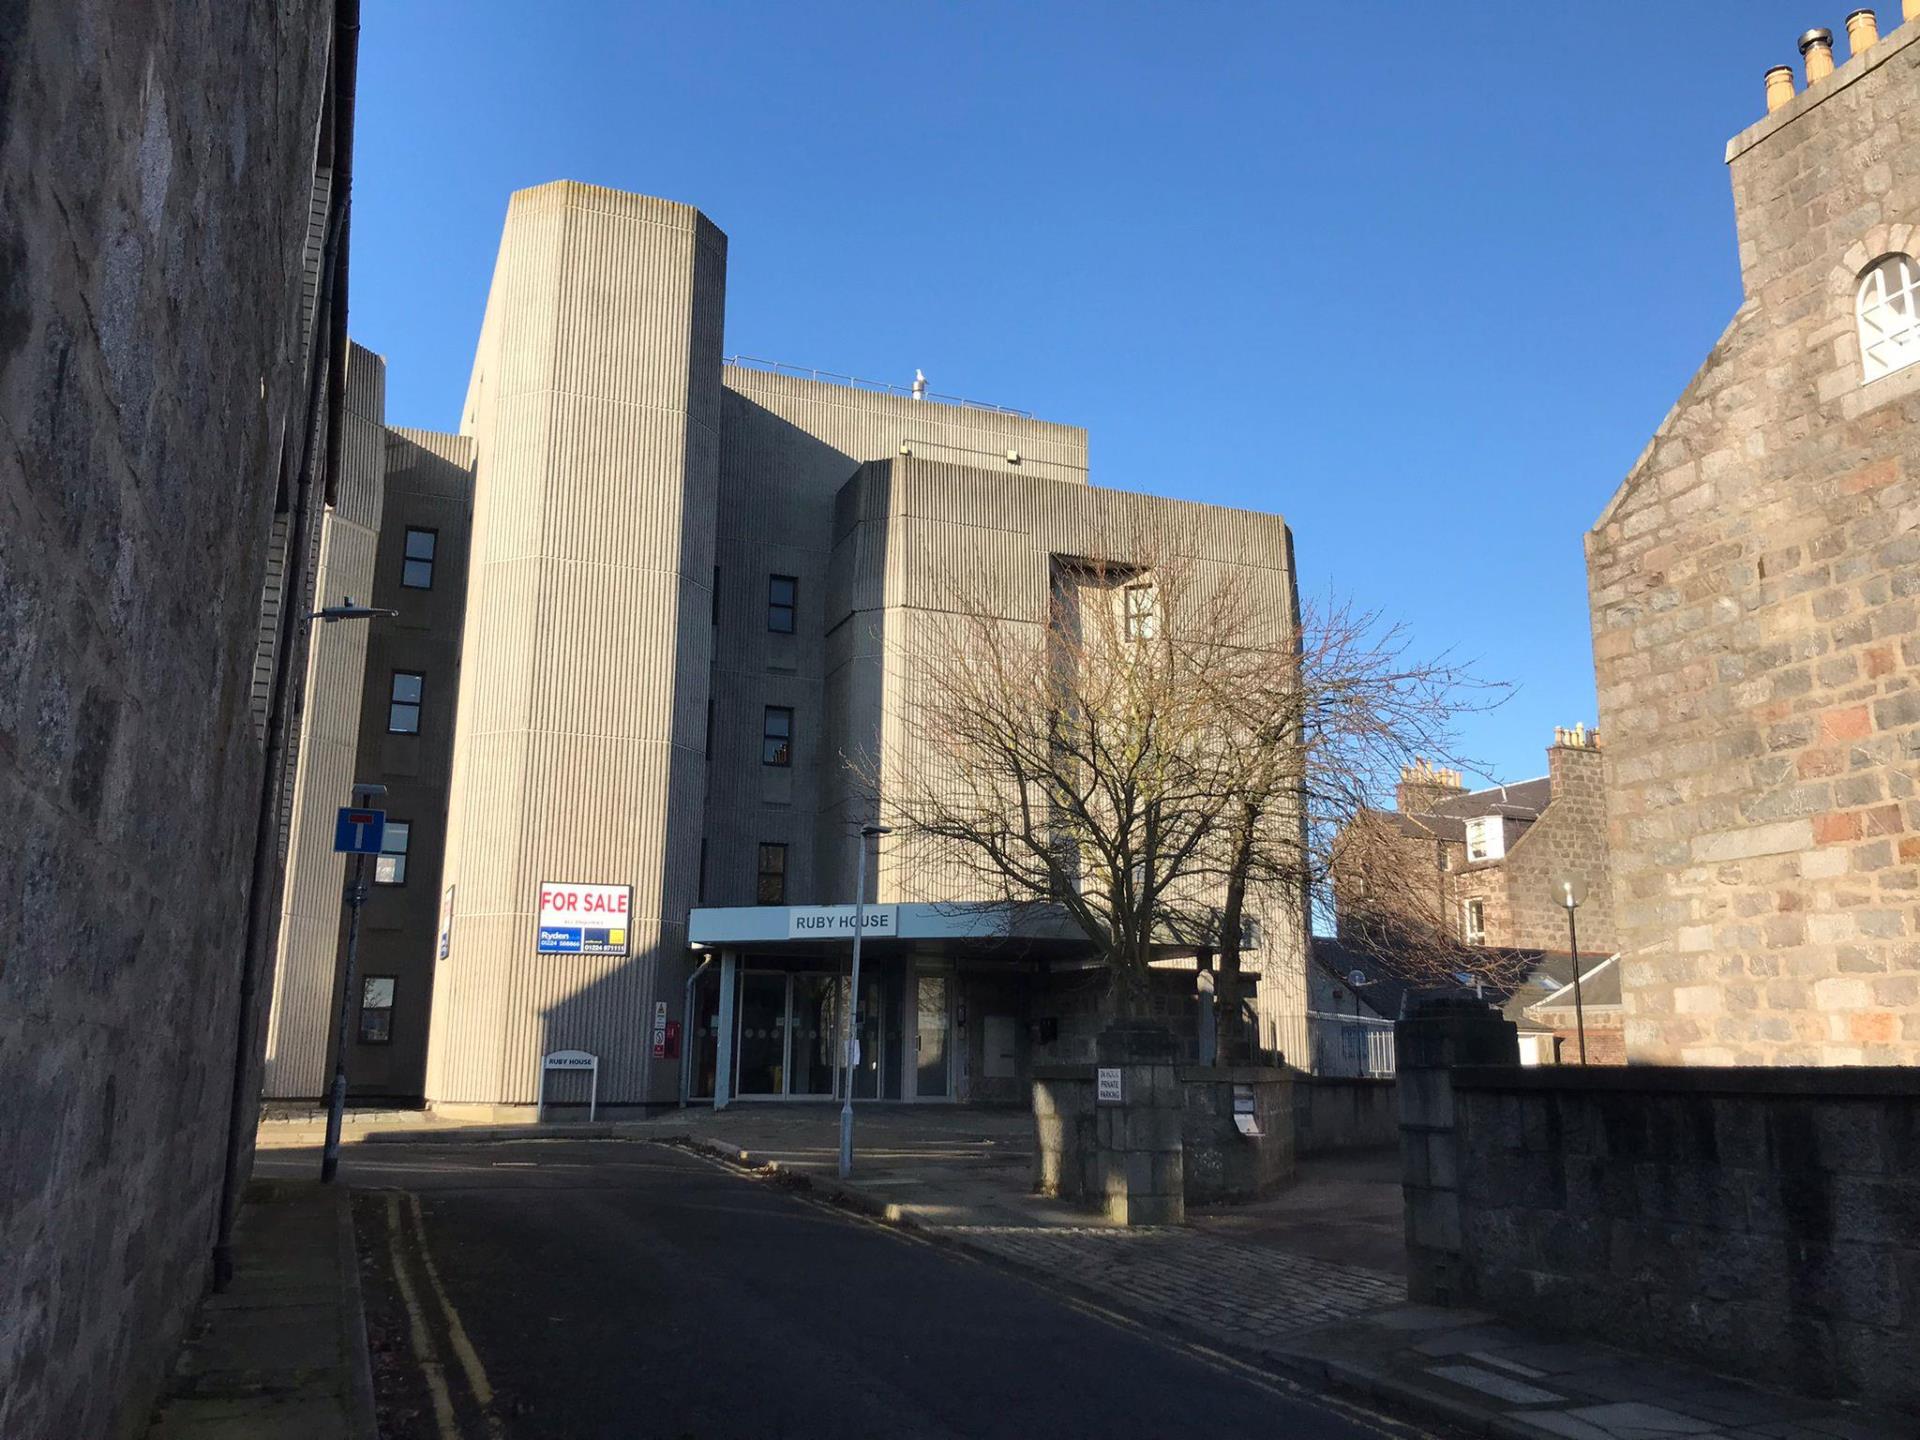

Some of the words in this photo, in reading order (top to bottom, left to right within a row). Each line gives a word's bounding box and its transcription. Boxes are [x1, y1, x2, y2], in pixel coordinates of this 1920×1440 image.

[541, 891, 578, 912] FOR
[583, 893, 628, 913] SALE
[796, 916, 835, 929] RUBY
[839, 914, 889, 928] HOUSE
[541, 931, 569, 940] Ryden
